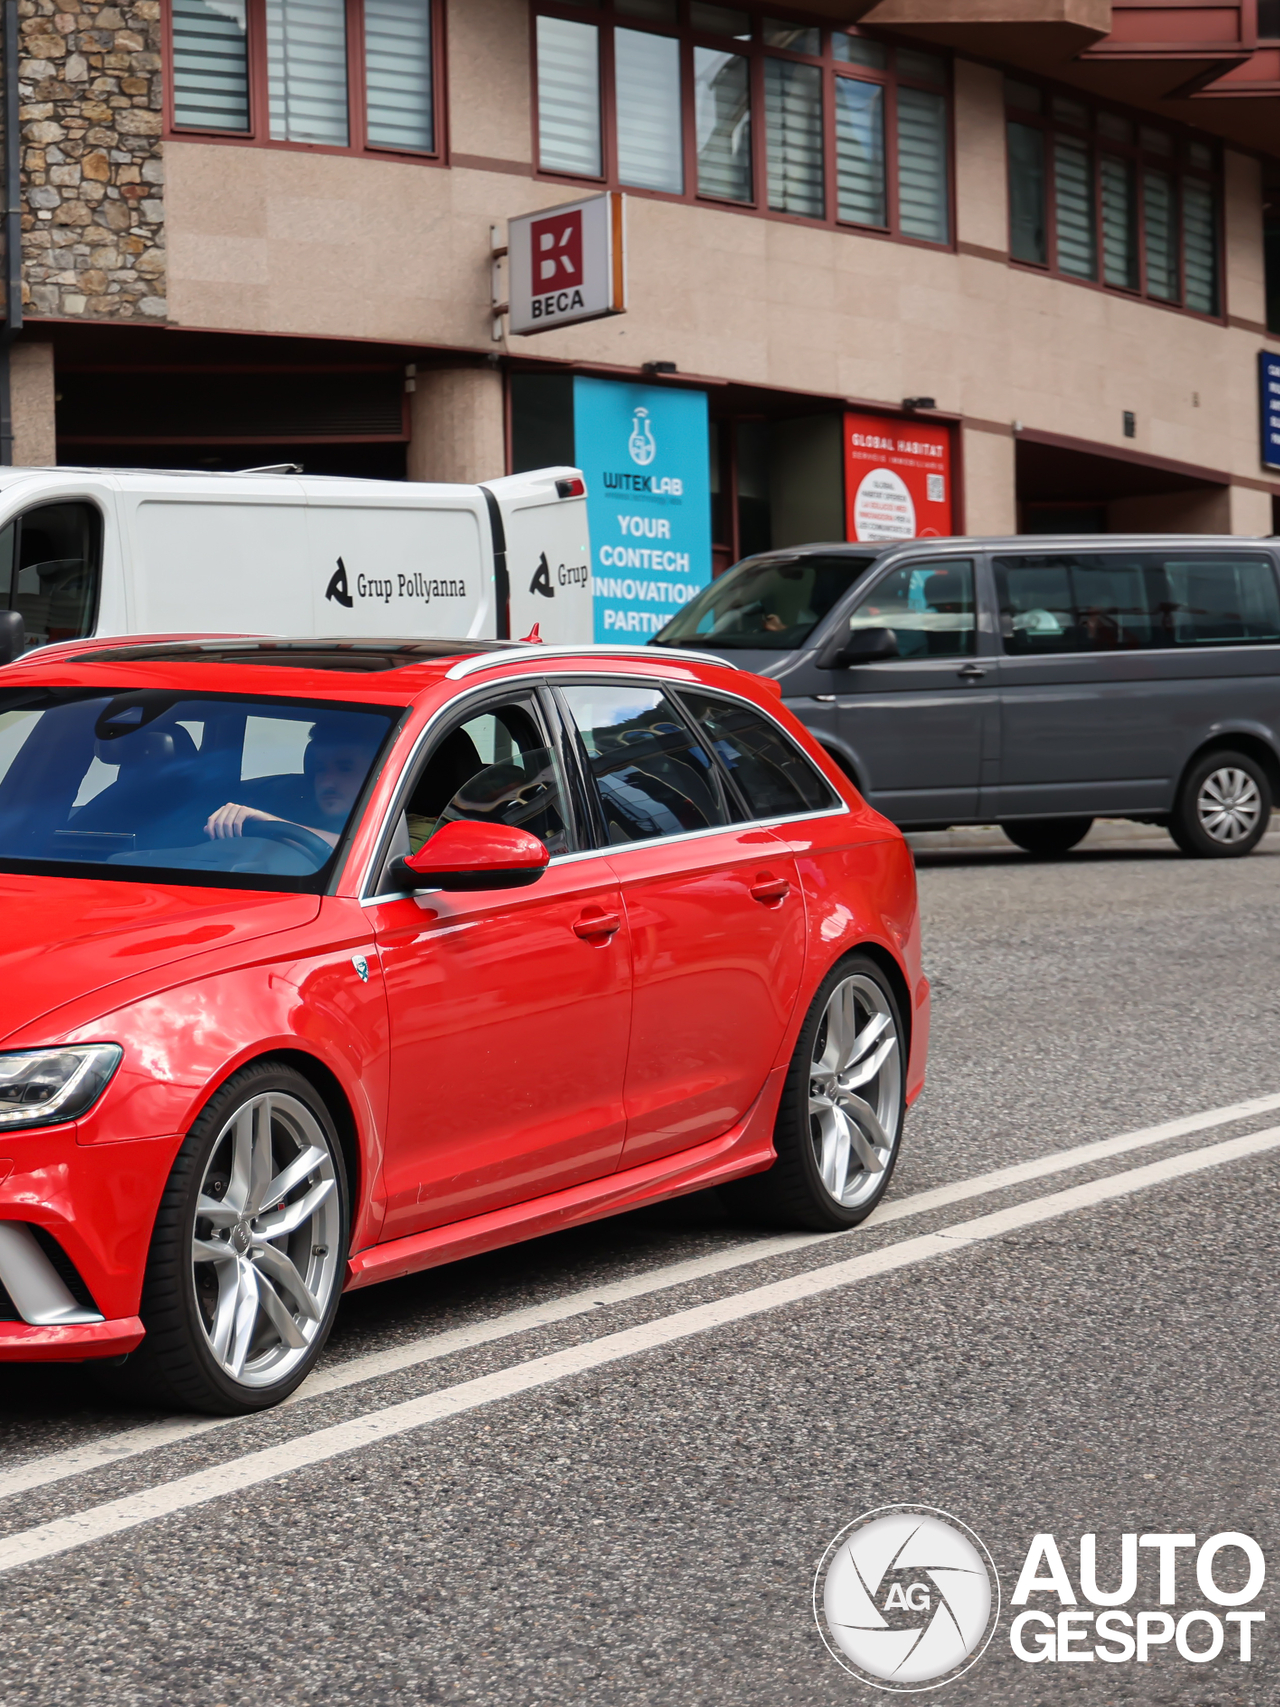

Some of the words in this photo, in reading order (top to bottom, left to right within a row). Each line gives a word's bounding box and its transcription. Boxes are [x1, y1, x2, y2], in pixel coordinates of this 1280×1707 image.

[532, 290, 584, 319] BECA
[852, 433, 895, 451] GLOBAL
[897, 440, 944, 457] HABITAT
[603, 472, 683, 496] WITEKLAB
[617, 515, 670, 540] YOUR
[599, 545, 690, 573] CONTECH
[357, 573, 393, 604] Grup
[397, 572, 466, 604] Pollyanna
[558, 564, 588, 588] Grup
[592, 576, 700, 605] INNOVATION
